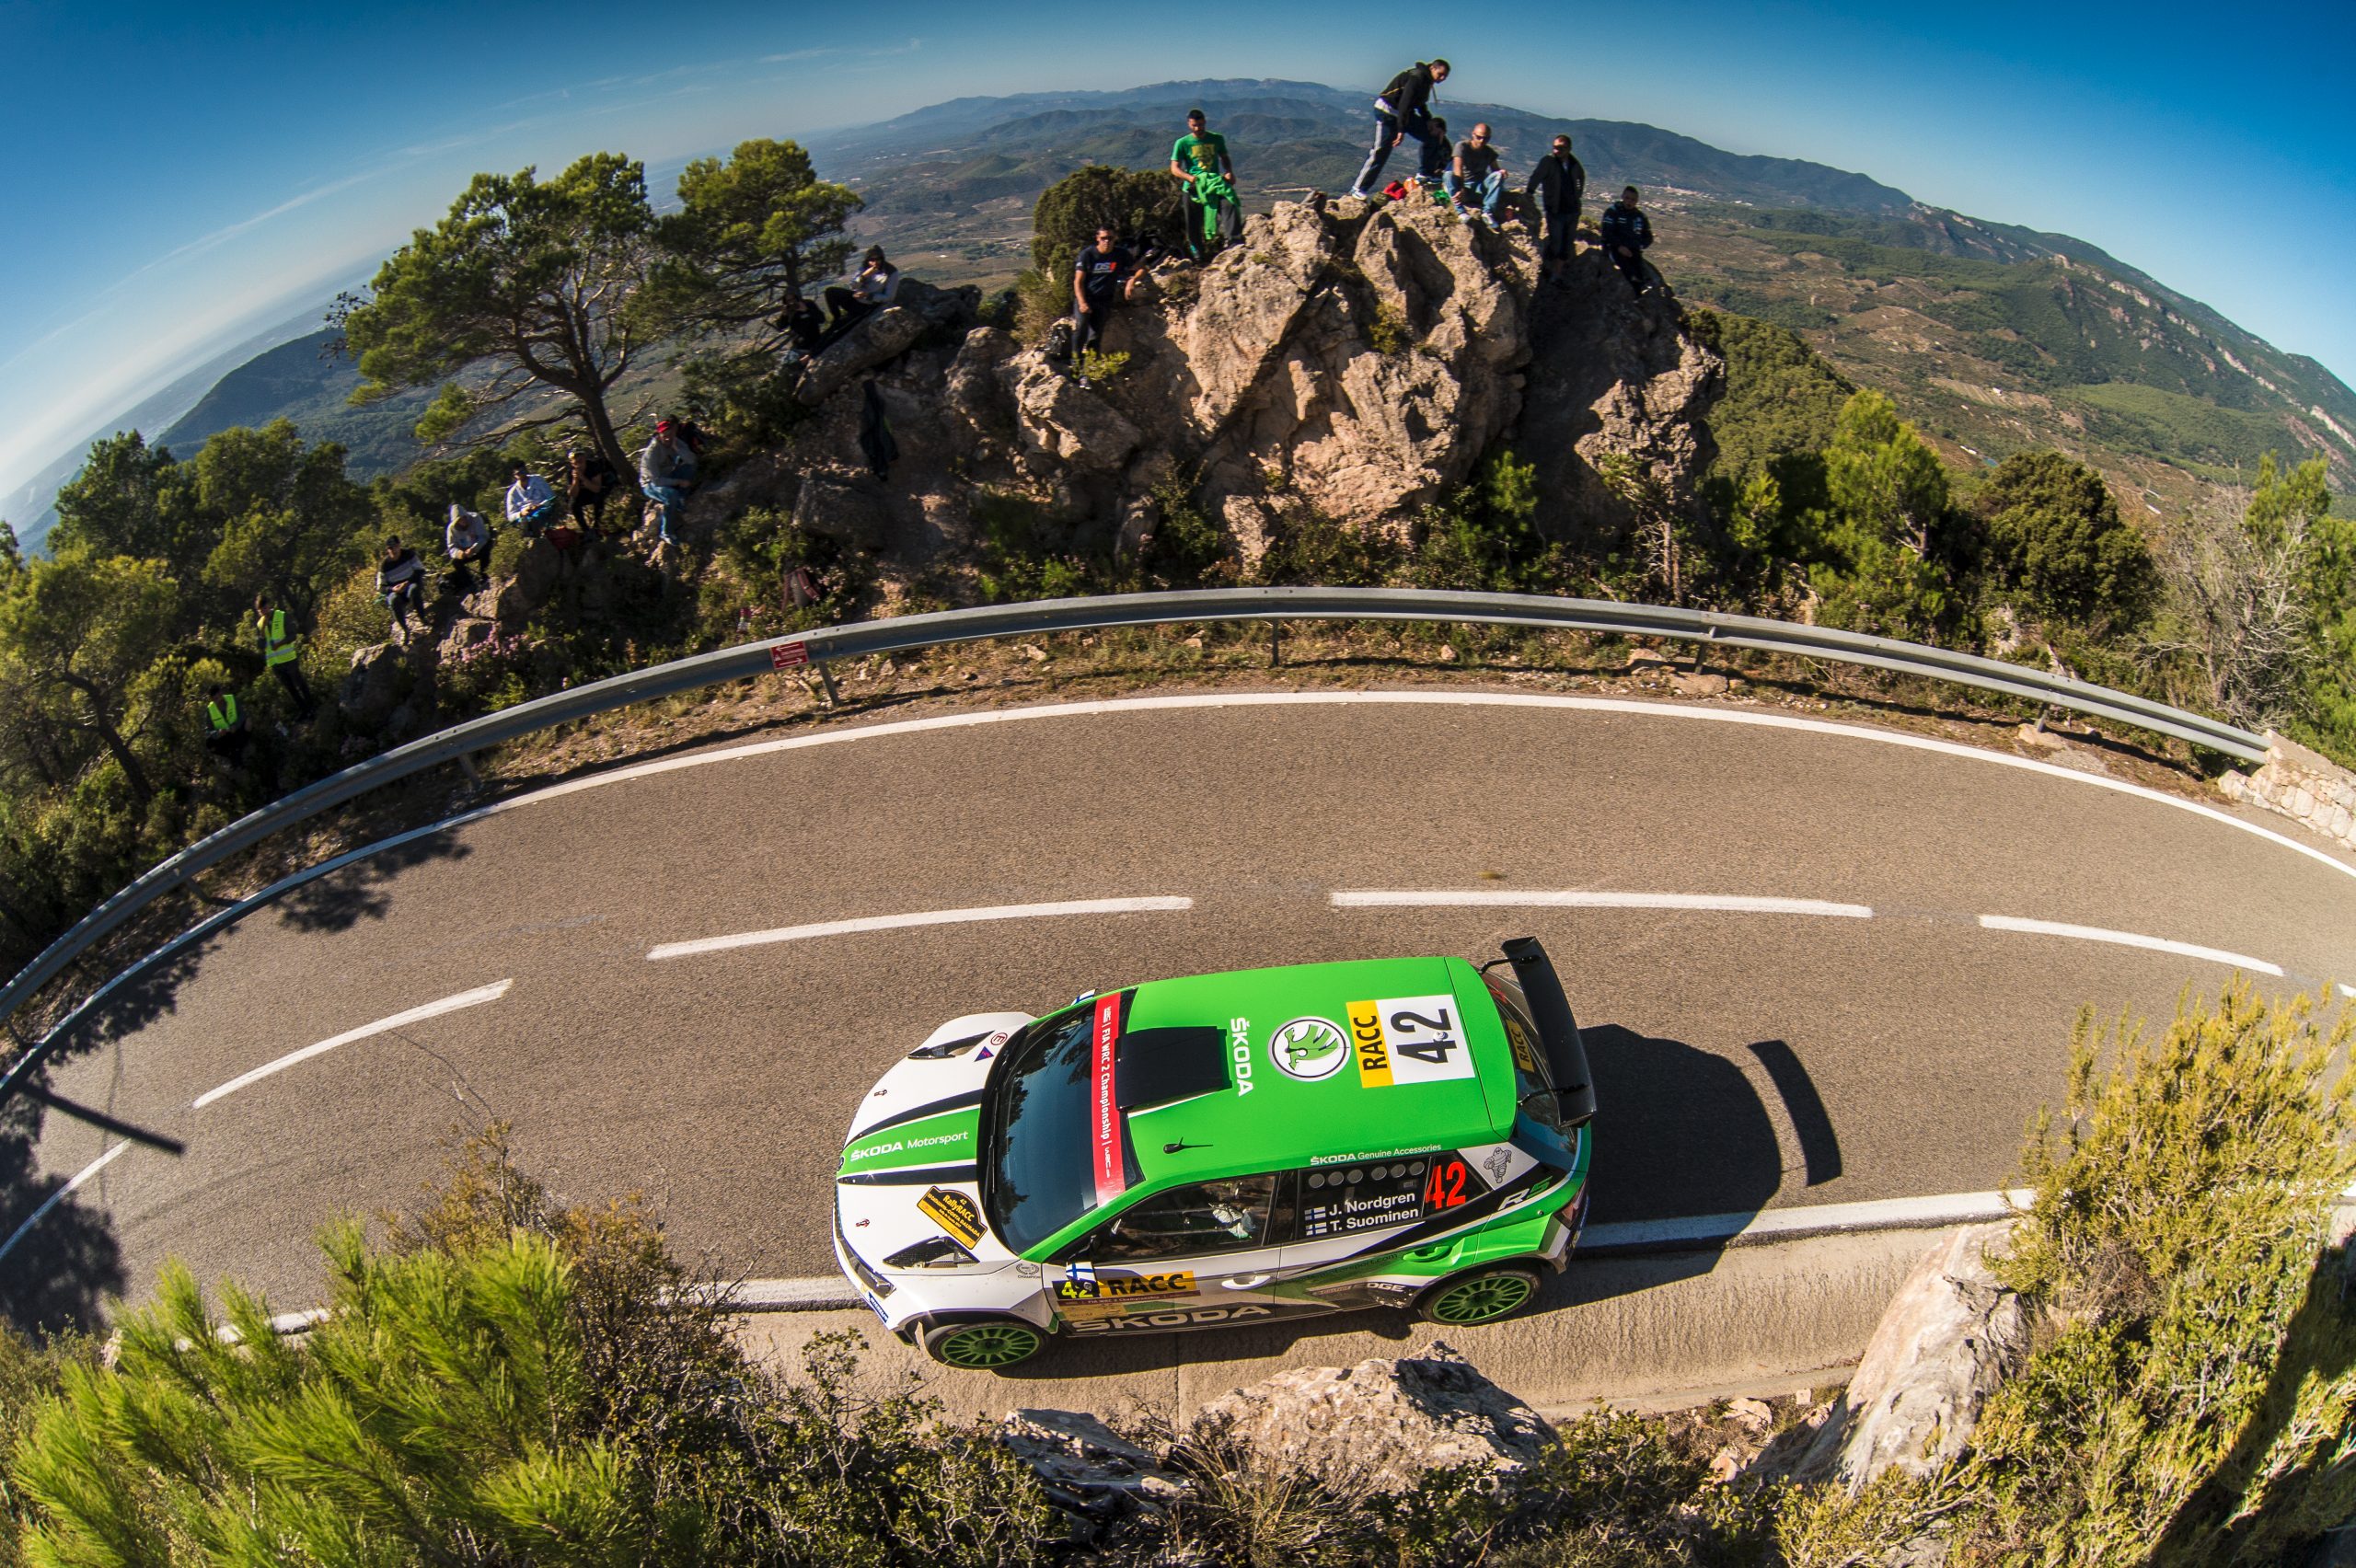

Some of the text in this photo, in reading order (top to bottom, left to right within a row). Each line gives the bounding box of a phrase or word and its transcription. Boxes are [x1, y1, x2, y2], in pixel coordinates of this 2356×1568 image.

[1102, 1028, 1111, 1043] FIA
[1353, 1015, 1387, 1071] RACC
[1391, 1009, 1457, 1064] 42
[1511, 1029, 1530, 1063] RACC
[1102, 1043, 1111, 1064] WRC
[1230, 1017, 1254, 1097] ŠKODA
[1100, 1073, 1111, 1140] Championship
[850, 1131, 968, 1161] ŠKODA Motorsport
[1310, 1144, 1441, 1166] ŠKODA Genuine Accessories
[1425, 1161, 1466, 1210] 42
[1497, 1175, 1553, 1211] R5
[942, 1194, 975, 1222] RallyRACC
[1329, 1192, 1415, 1216] J. Nordgren
[1330, 1209, 1419, 1232] T. Suominen
[1107, 1274, 1186, 1296] RACC
